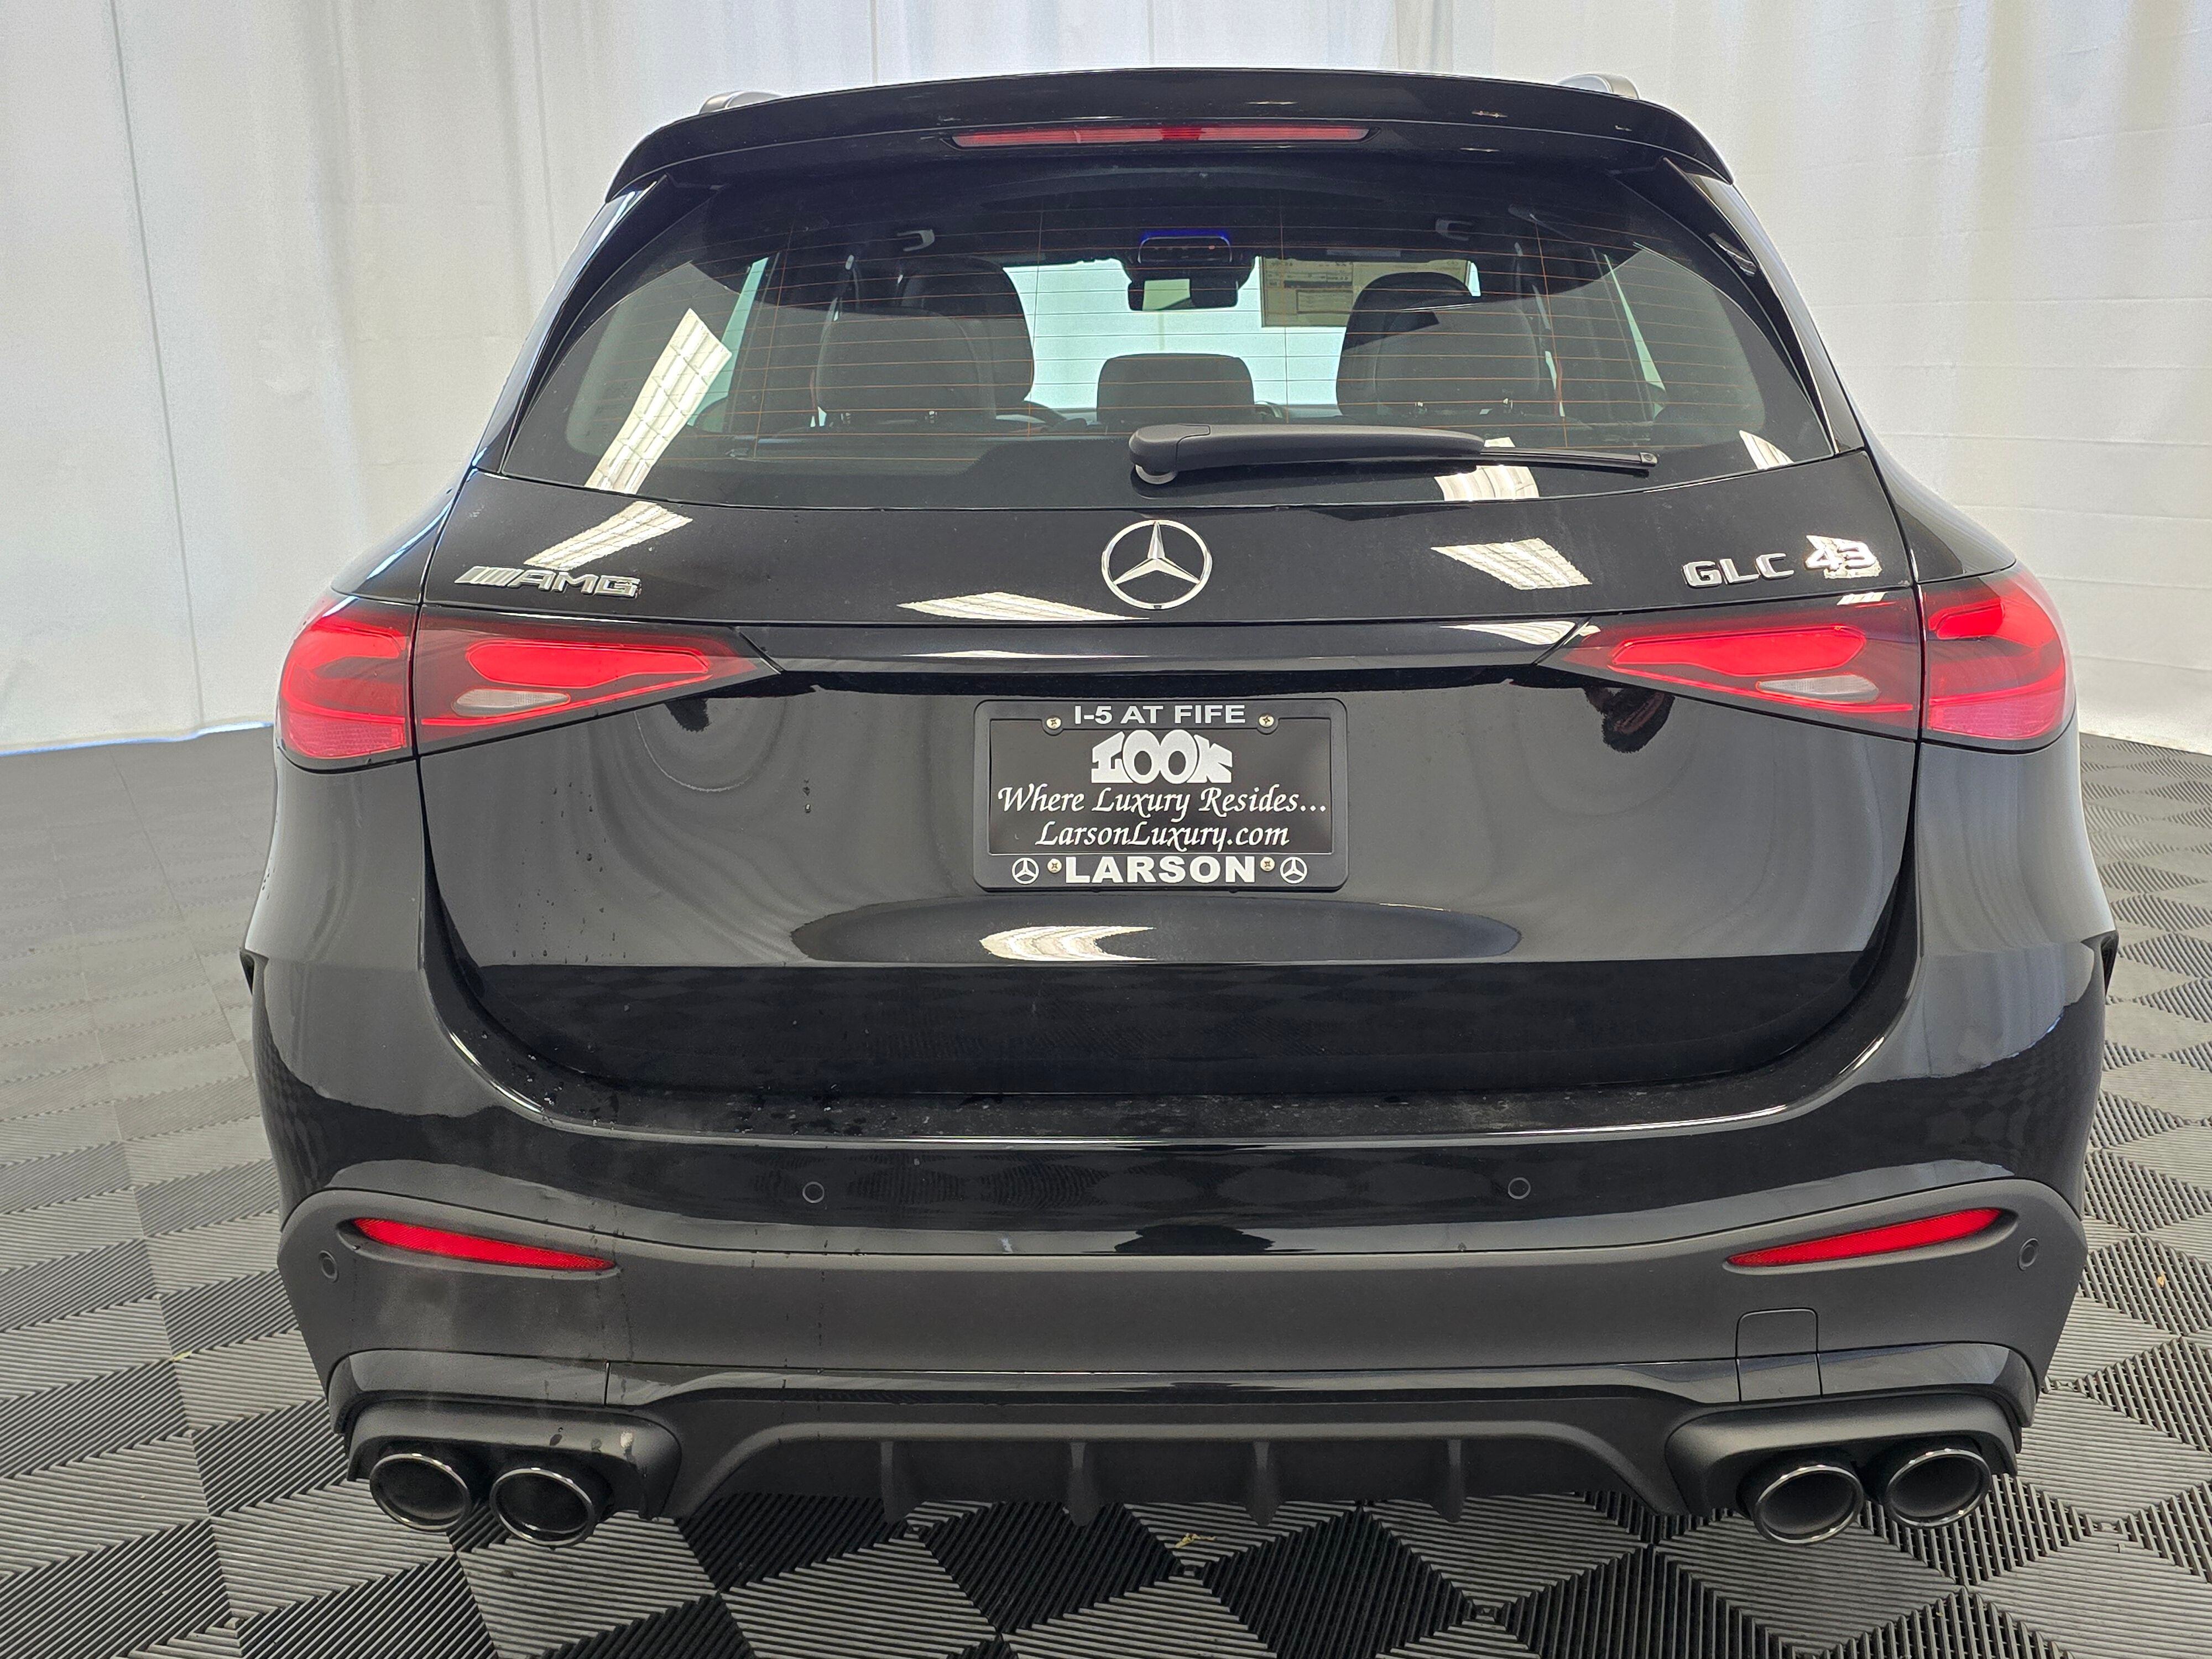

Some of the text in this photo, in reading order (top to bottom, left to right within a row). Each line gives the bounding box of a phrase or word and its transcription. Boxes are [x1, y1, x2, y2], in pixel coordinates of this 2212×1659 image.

[1682, 539, 1876, 587] GLC 43
[1074, 705, 1246, 724] I-5 AT FIFE
[997, 784, 1327, 823] Where Luxury Resides...
[1035, 821, 1290, 852] LarsonLuxury.com
[1065, 855, 1256, 884] LARSON
